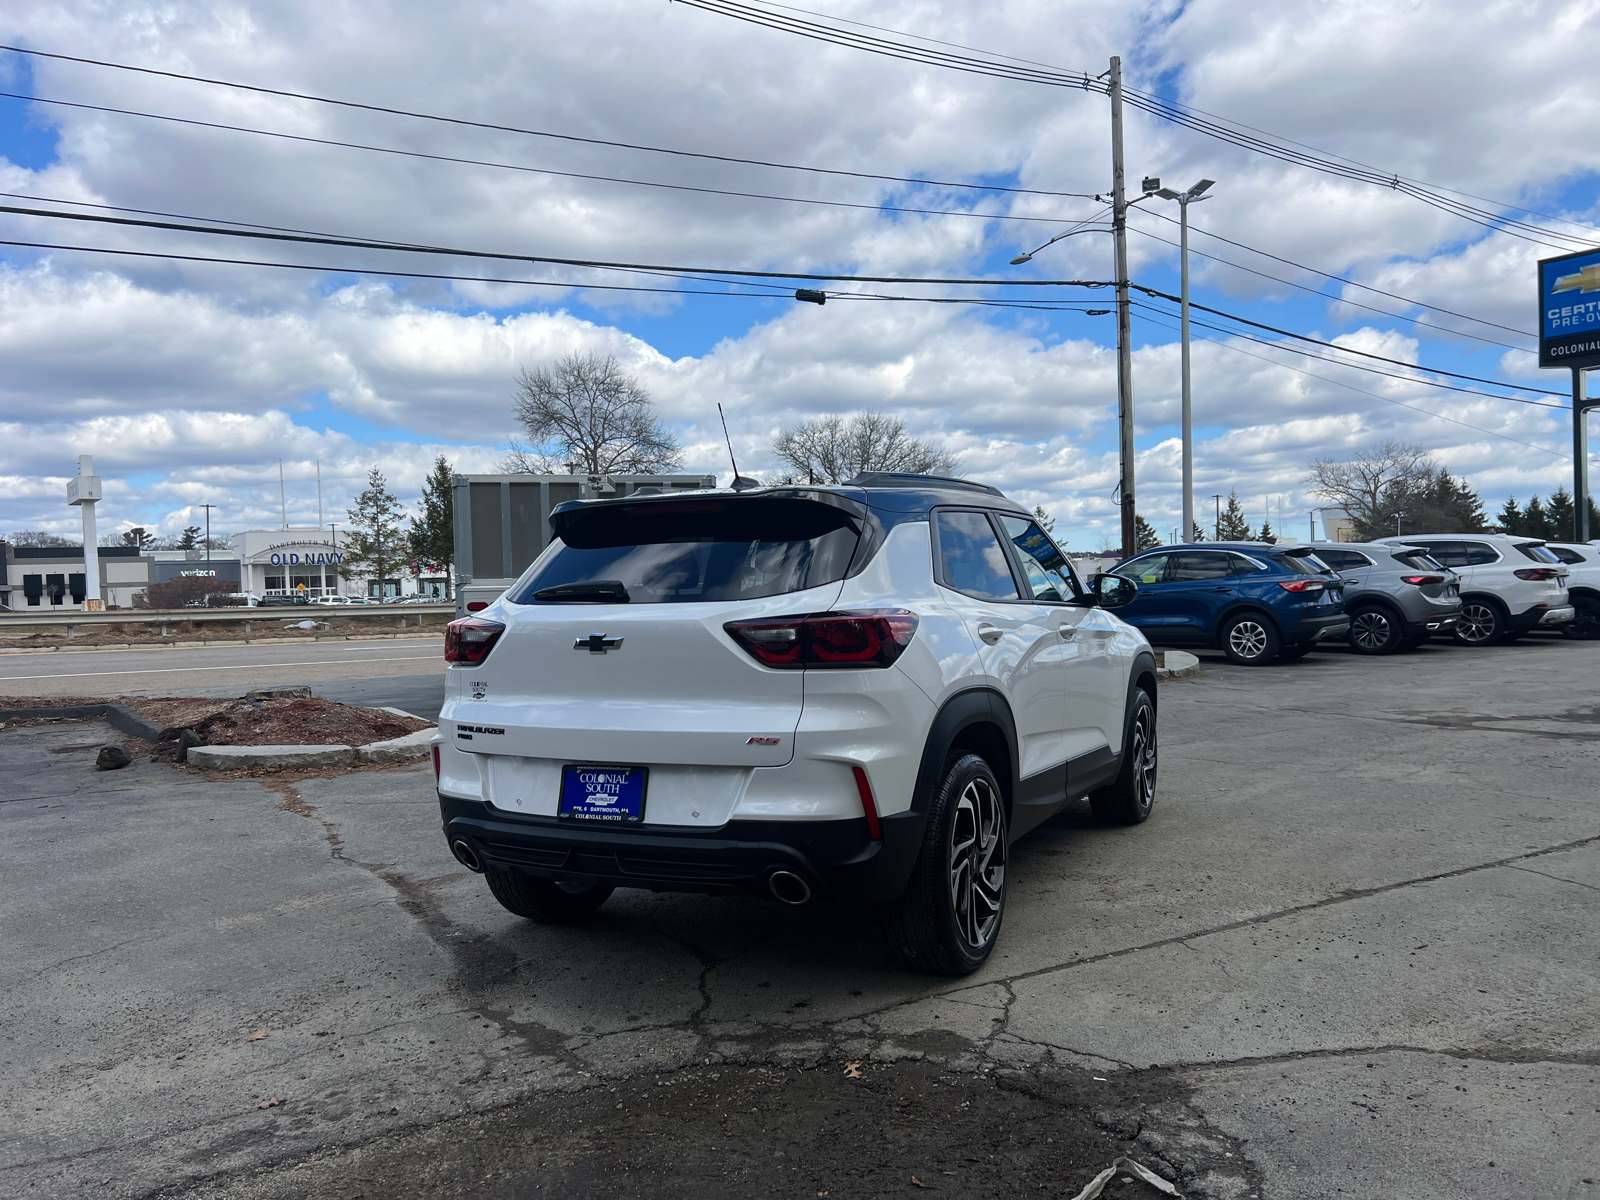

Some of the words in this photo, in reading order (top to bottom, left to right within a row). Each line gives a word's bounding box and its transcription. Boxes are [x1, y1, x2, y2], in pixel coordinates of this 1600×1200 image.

[270, 553, 300, 566] OLD
[305, 552, 344, 566] NAVY
[180, 568, 216, 577] verizon
[457, 724, 505, 735] TRAILBLAZER
[746, 736, 780, 745] RS
[580, 773, 628, 784] COLONIAL
[586, 783, 619, 793] SOUTH
